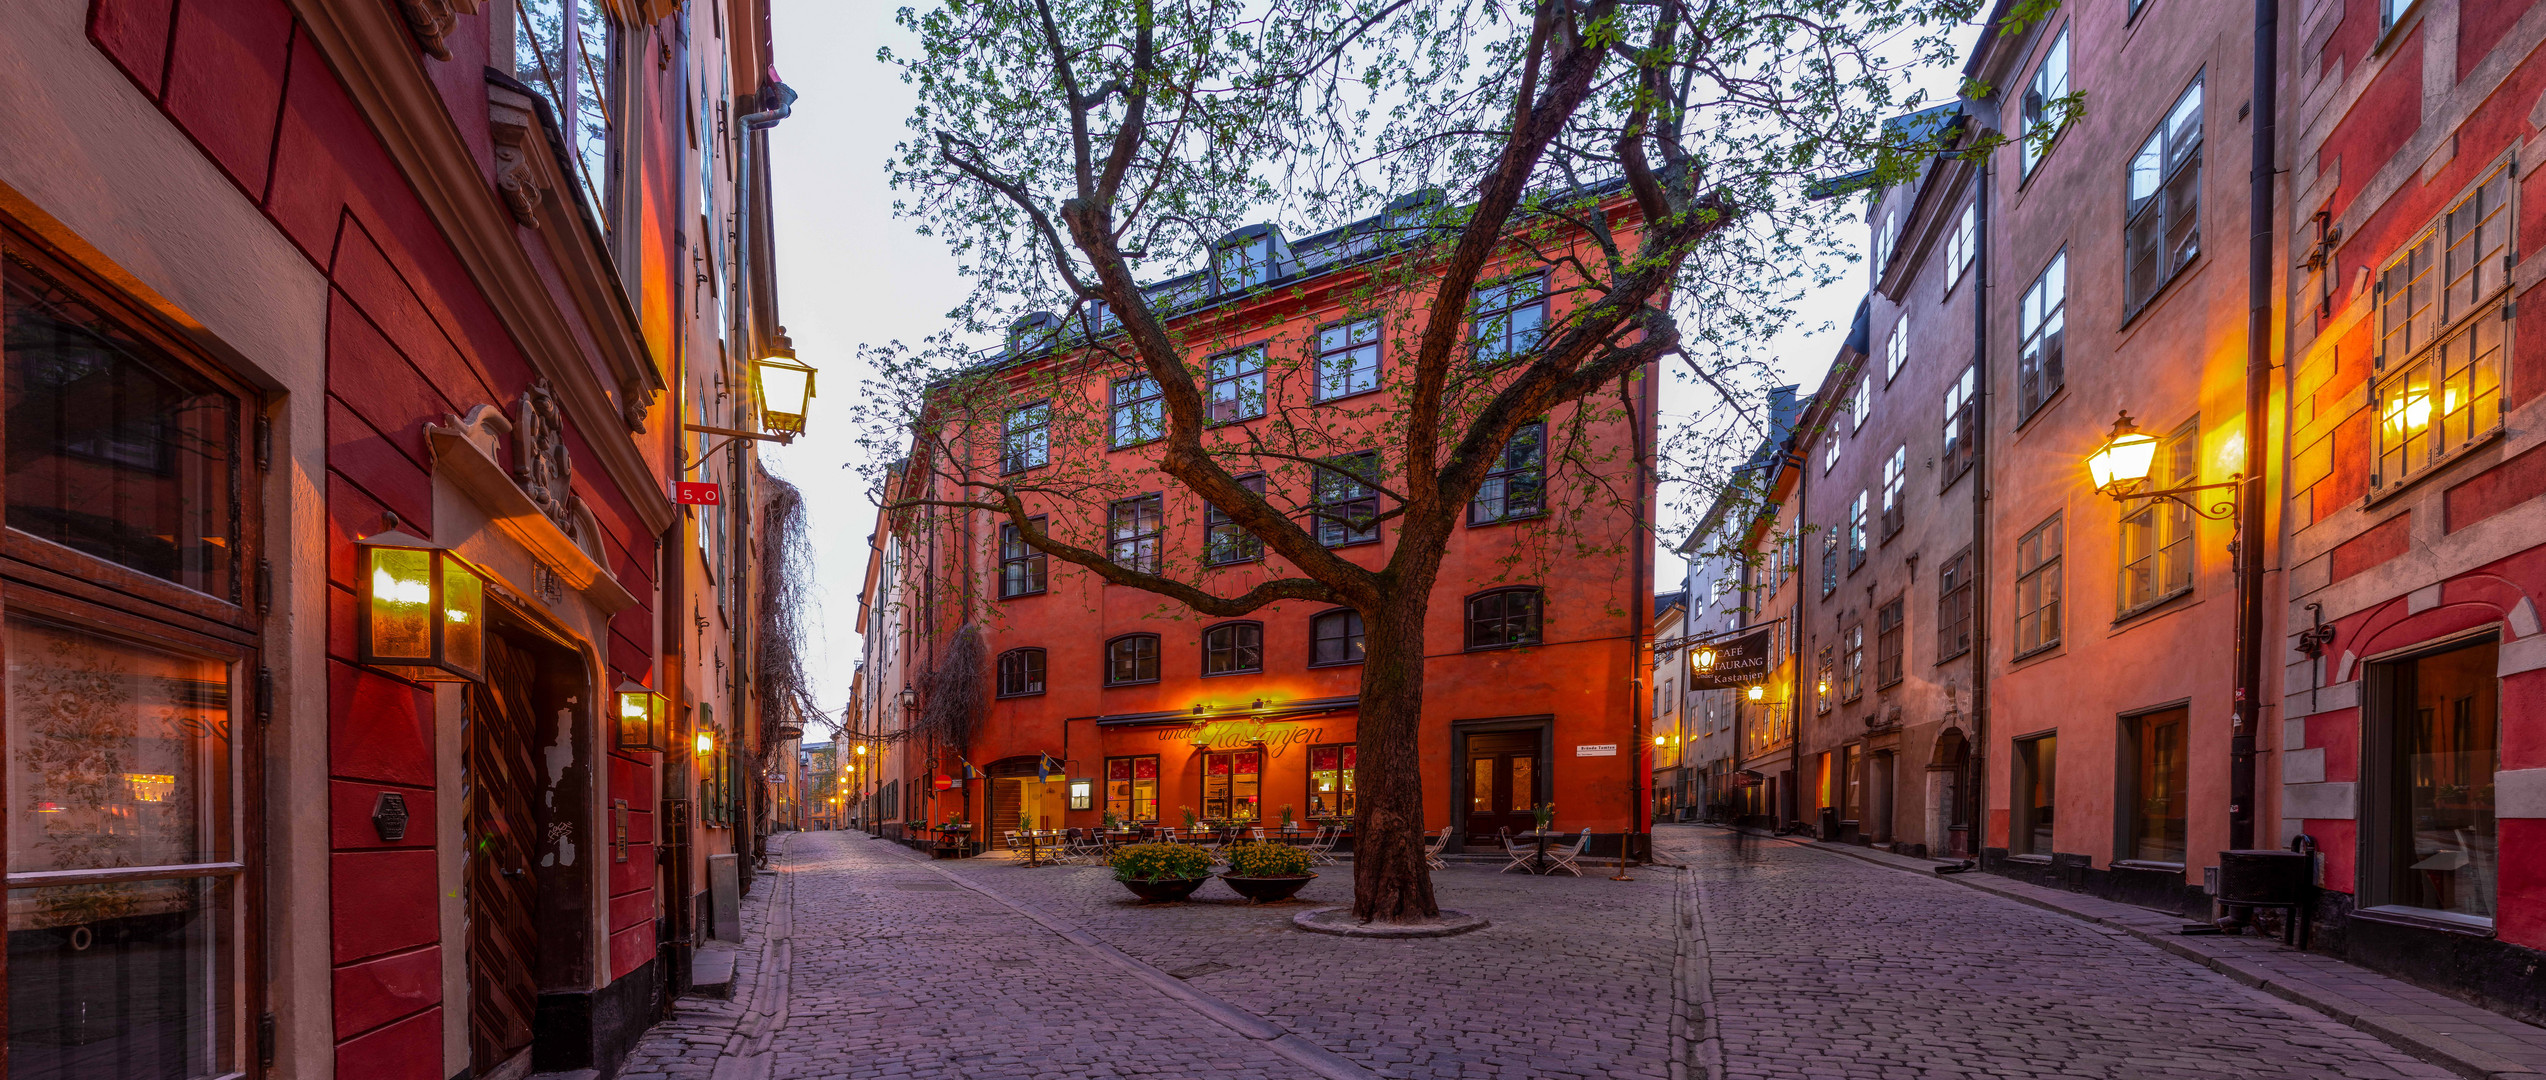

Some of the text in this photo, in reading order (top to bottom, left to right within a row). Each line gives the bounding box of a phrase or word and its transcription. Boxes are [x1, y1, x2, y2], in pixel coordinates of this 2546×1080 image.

[683, 489, 716, 503] 5,0
[1716, 645, 1743, 658] CAFÉ
[1714, 657, 1763, 671] TAURANG
[1714, 671, 1763, 684] Kastanjen
